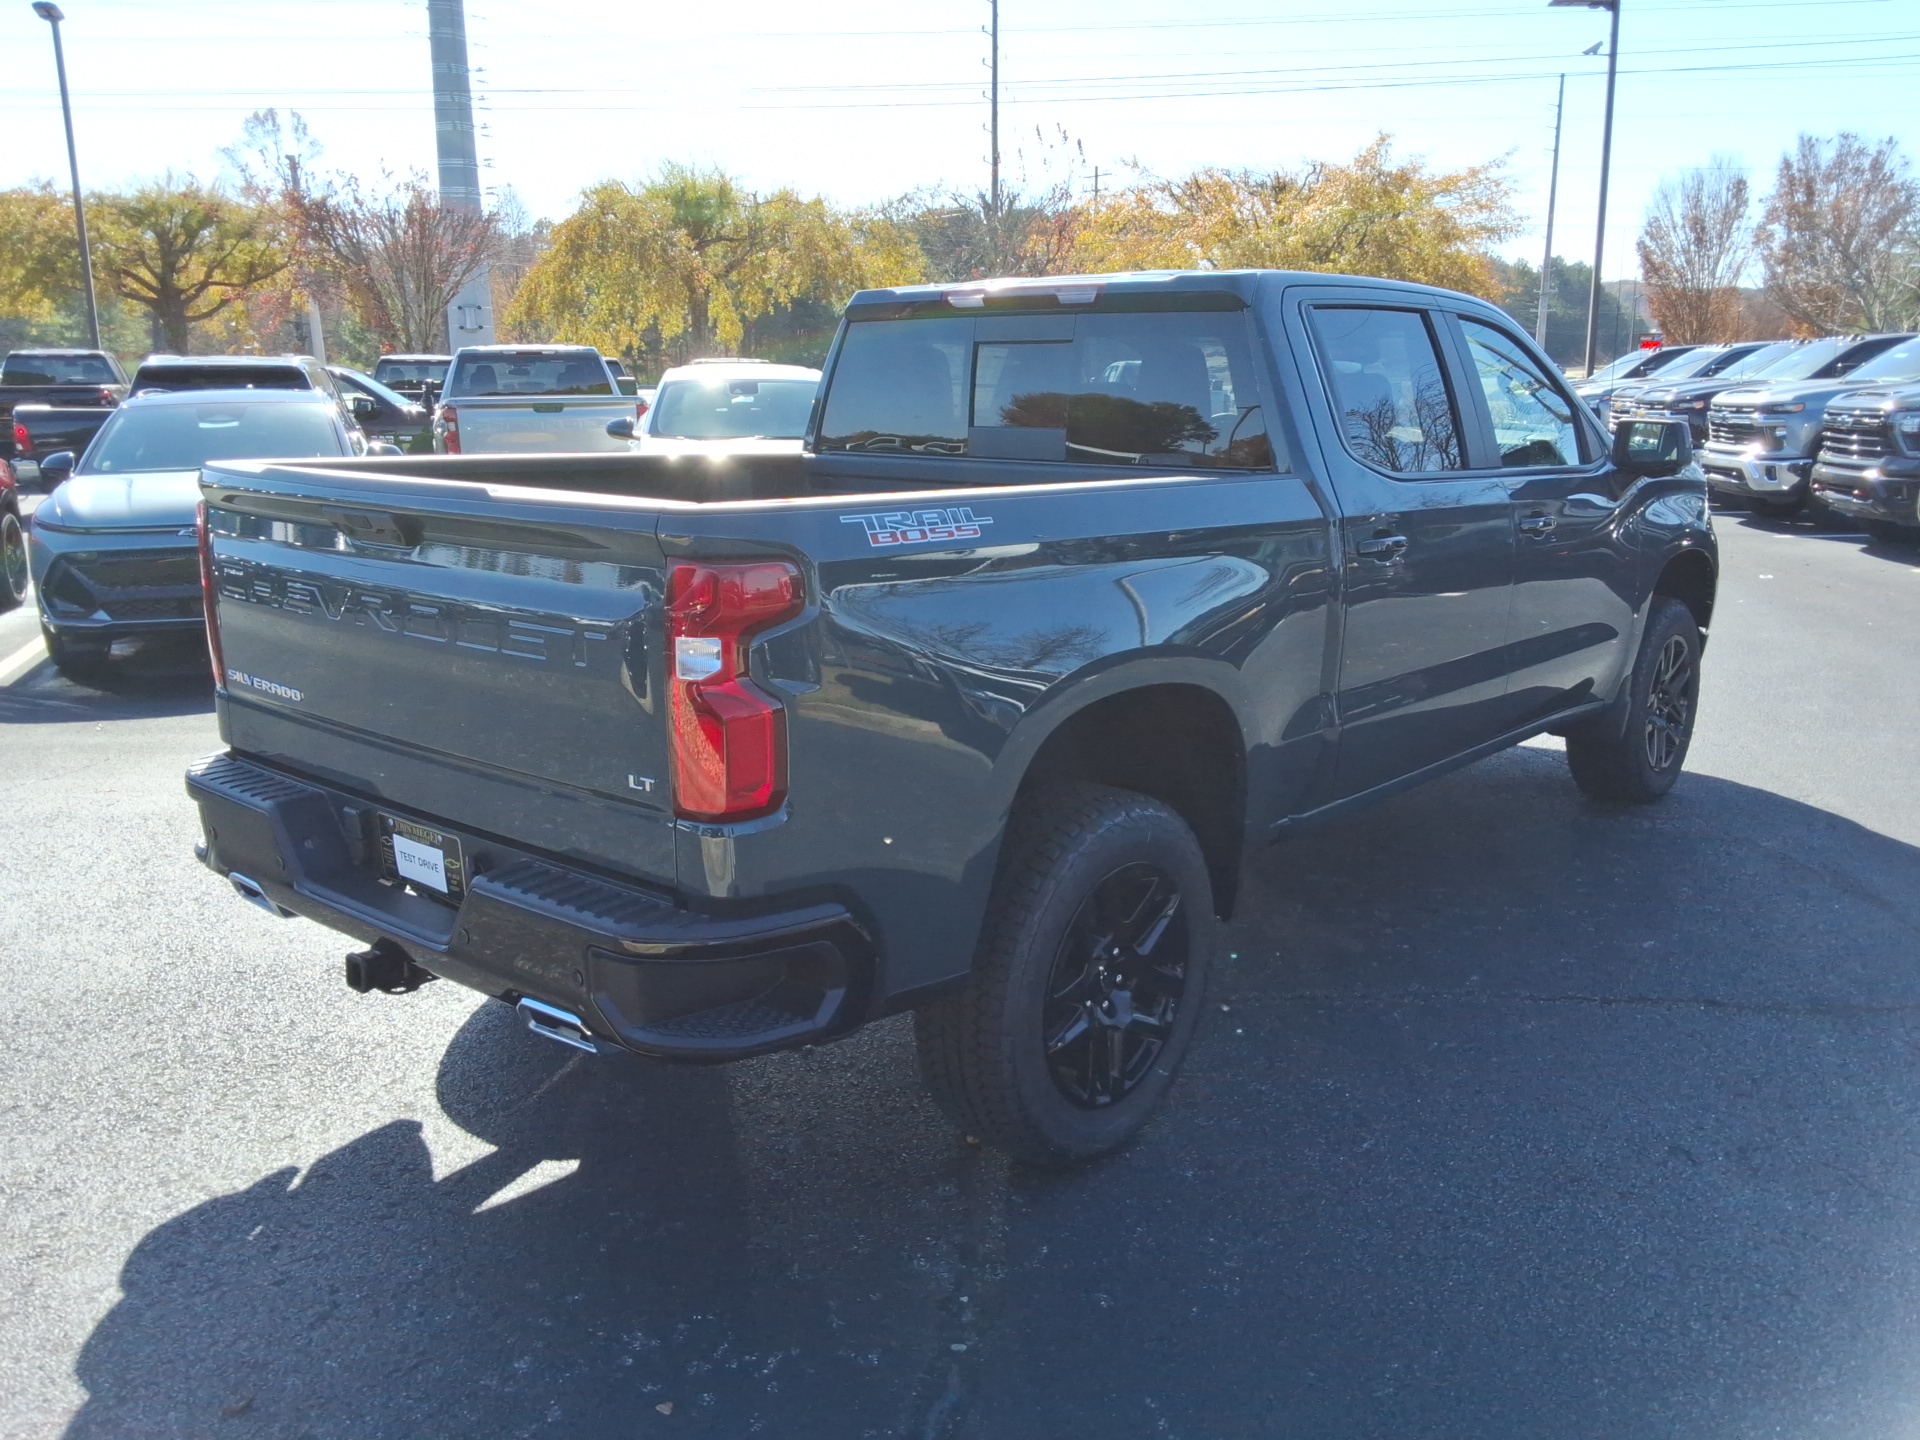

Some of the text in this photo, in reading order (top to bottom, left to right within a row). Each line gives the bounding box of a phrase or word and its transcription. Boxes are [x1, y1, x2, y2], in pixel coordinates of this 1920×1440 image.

[839, 507, 994, 532] TRAIL
[867, 523, 981, 547] BOSS
[227, 668, 304, 702] SILVERADO
[628, 774, 656, 792] LT
[399, 850, 416, 864] TEST
[417, 857, 440, 873] DRIVE
